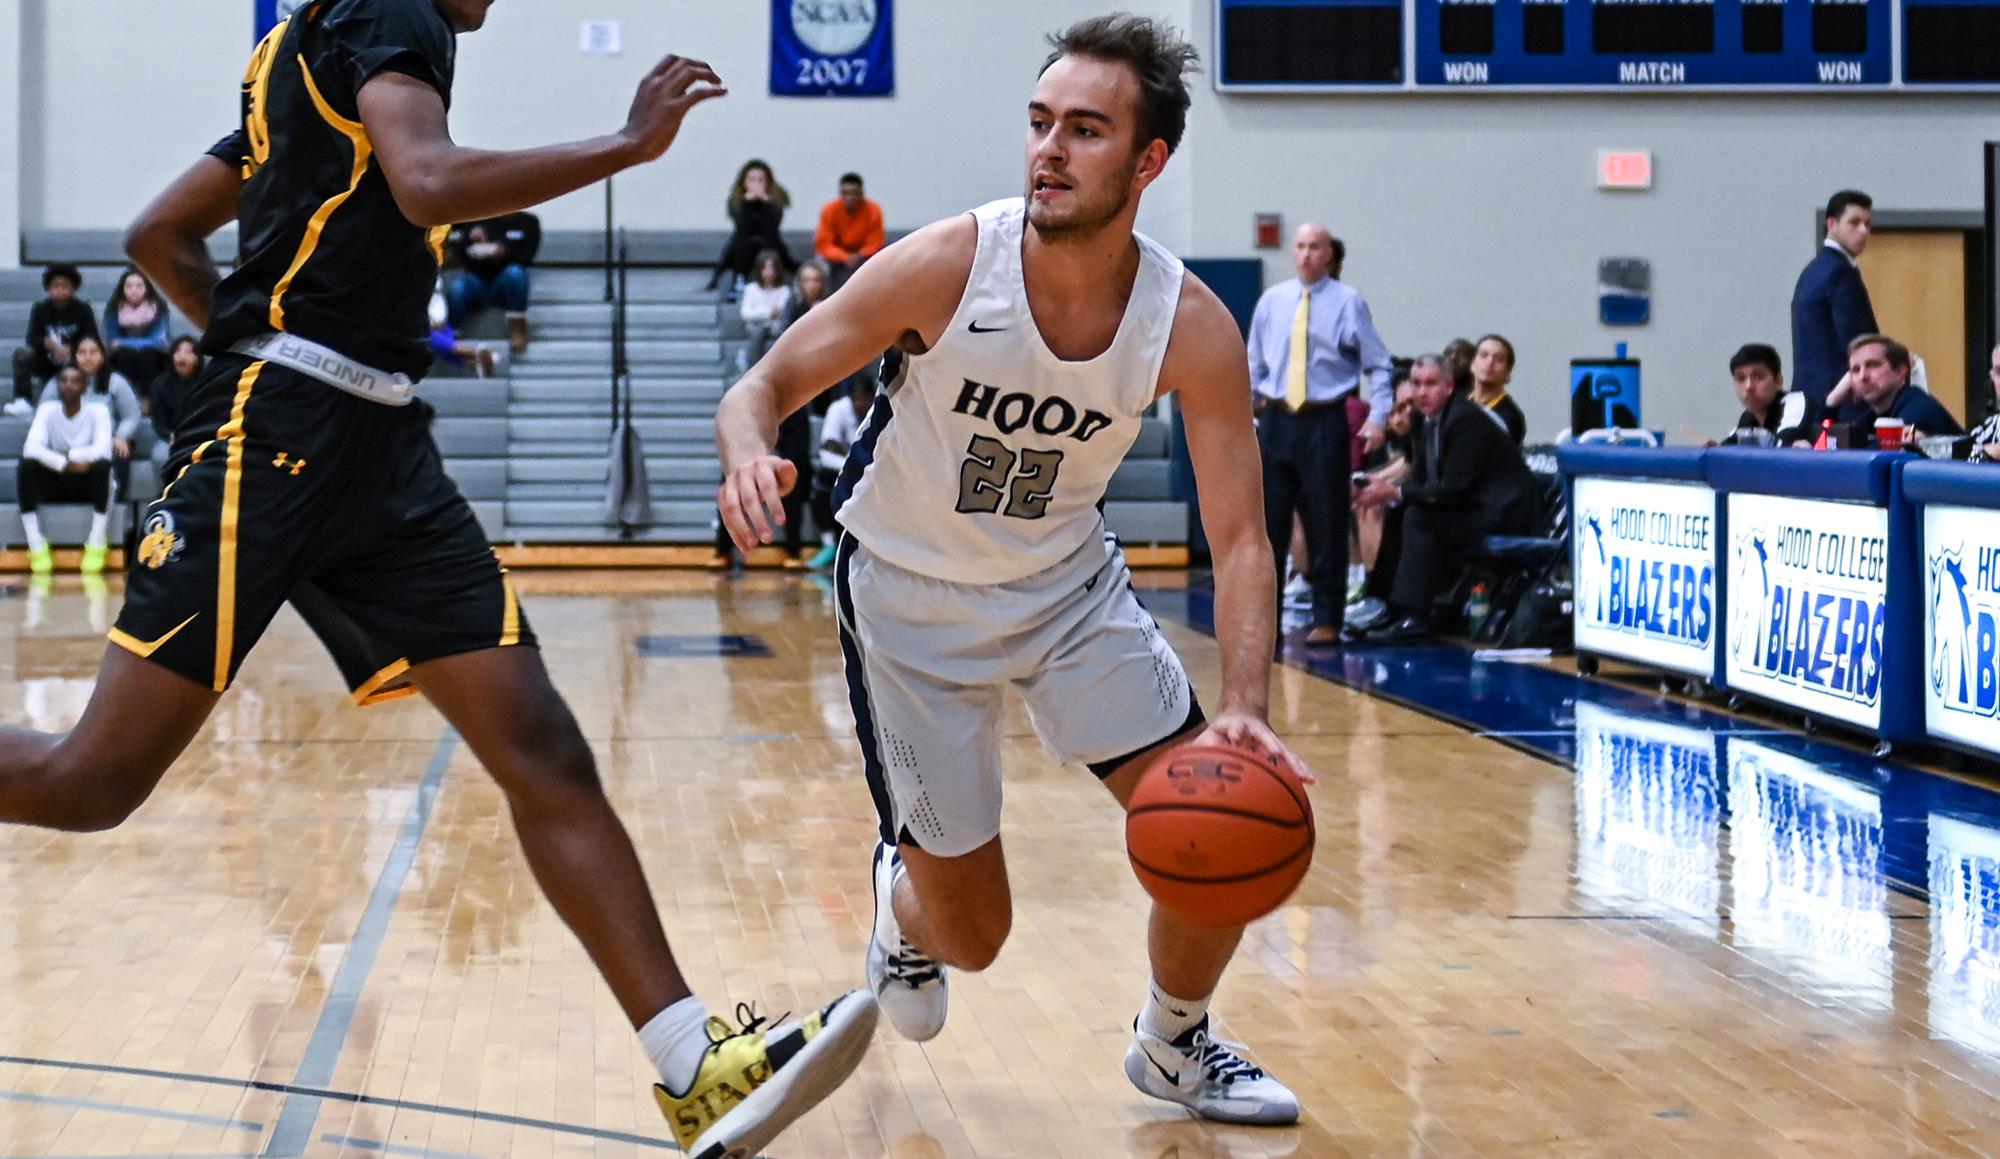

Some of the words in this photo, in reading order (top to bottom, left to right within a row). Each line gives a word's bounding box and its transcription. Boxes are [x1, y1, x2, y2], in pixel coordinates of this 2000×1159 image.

[796, 58, 869, 85] 2007
[1443, 62, 1488, 82] WON
[1619, 62, 1685, 82] MATCH
[1818, 61, 1861, 82] WON
[278, 341, 377, 391] UNDER
[951, 378, 1112, 442] HOOD
[955, 433, 1064, 520] 22
[1611, 507, 1646, 542] HOOD
[1650, 511, 1709, 551] COLLEGE
[1776, 525, 1813, 570] HOOD
[1815, 532, 1884, 583] COLLEGE
[1608, 555, 1713, 644] BLAZERS
[1766, 584, 1885, 700] BLAZERS
